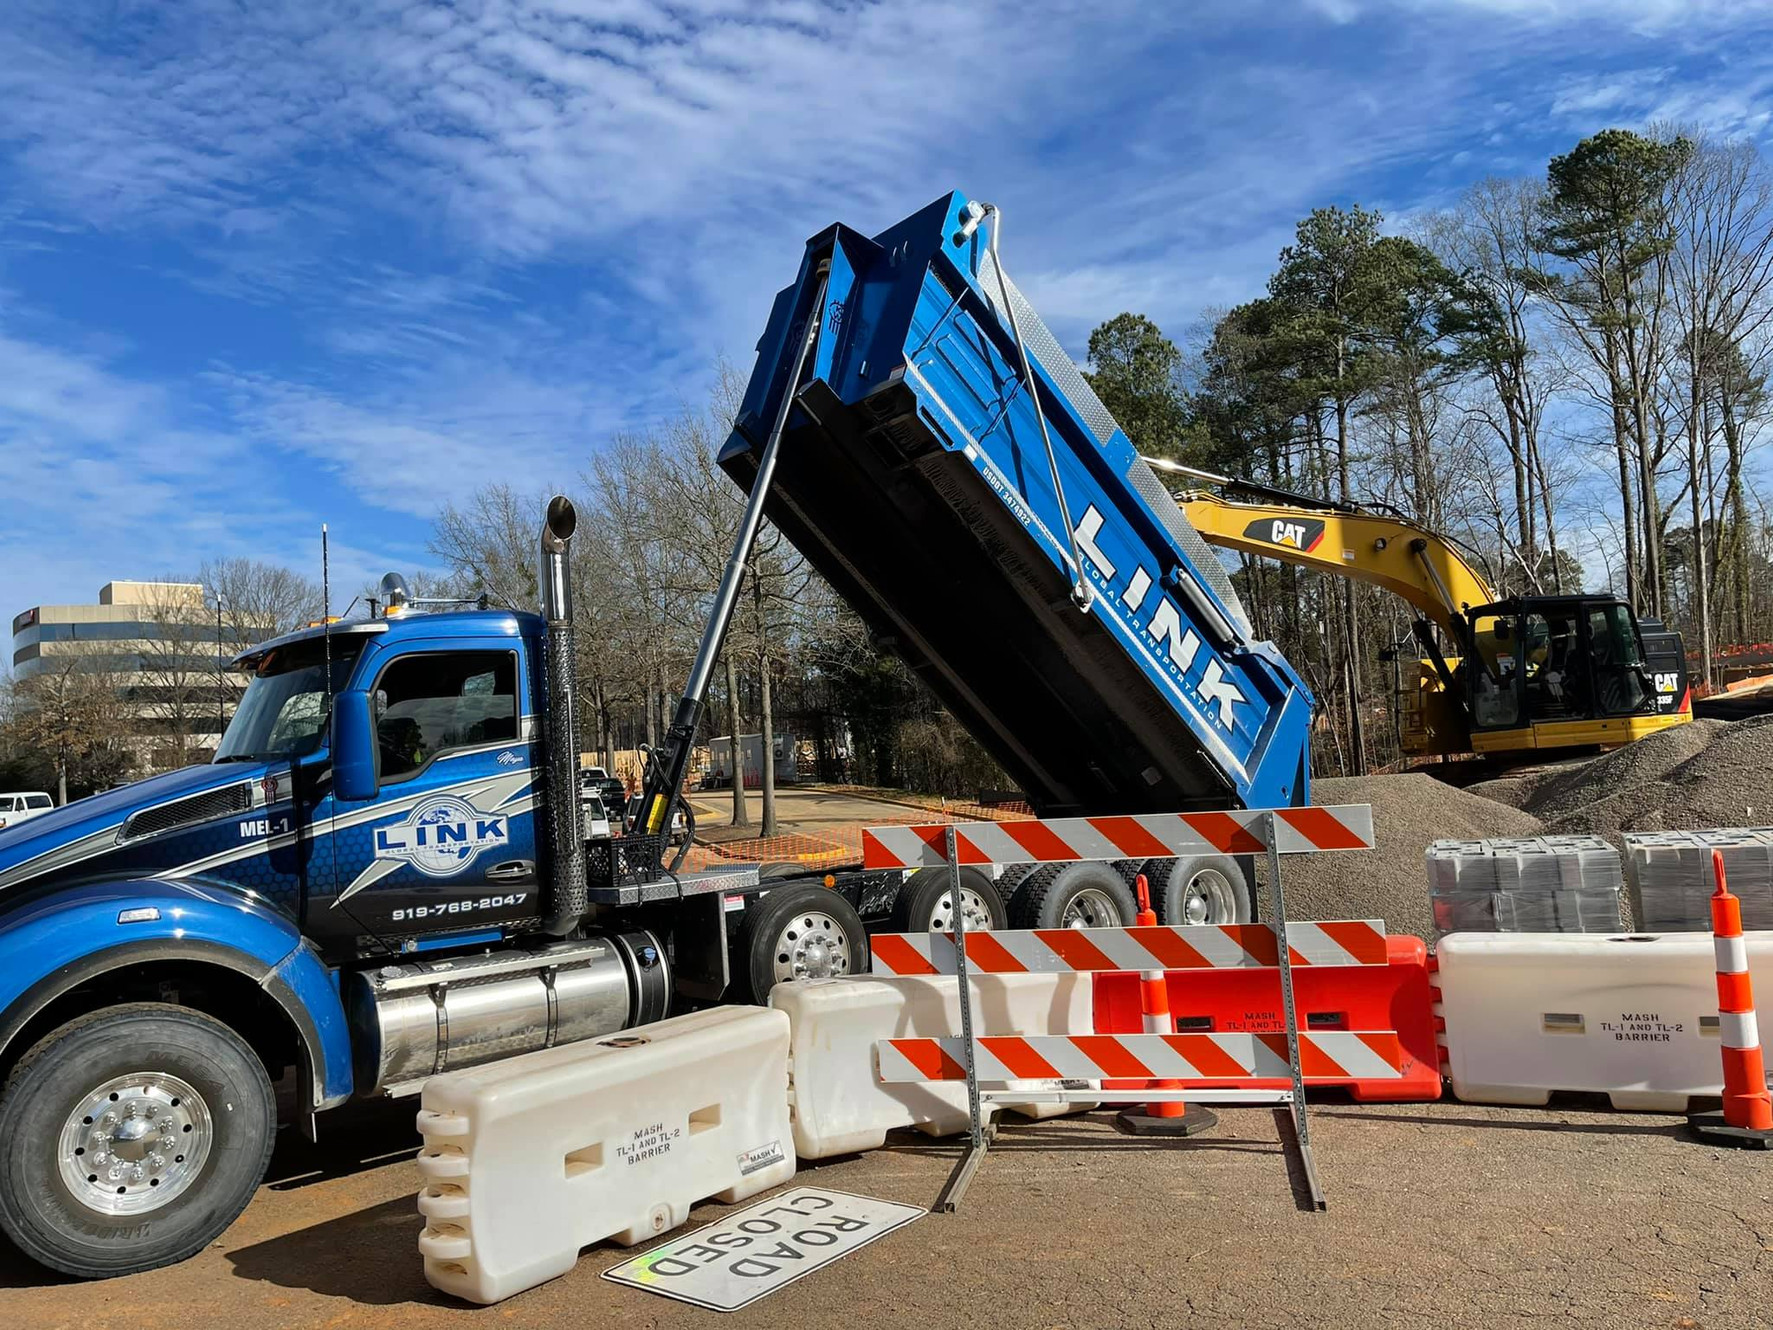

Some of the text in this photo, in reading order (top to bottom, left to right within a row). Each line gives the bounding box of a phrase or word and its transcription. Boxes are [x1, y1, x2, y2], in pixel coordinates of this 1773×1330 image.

[983, 467, 1004, 492] USDOT
[1272, 520, 1306, 549] CAT
[1075, 503, 1249, 734] LINK
[1126, 610, 1221, 729] TRANSPORTATION
[1655, 673, 1678, 692] CAT
[240, 818, 288, 837] MEL-1
[377, 819, 505, 850] LINK
[424, 838, 500, 850] TRANSPORTATION
[392, 893, 527, 920] 919-768-2047
[1244, 1012, 1275, 1020] MASH
[1600, 1023, 1624, 1031] TL-1
[1656, 1024, 1684, 1032] TL-2
[1621, 1013, 1659, 1021] MASH
[1615, 1033, 1670, 1041] BARRIER
[634, 1122, 663, 1140] MASH
[616, 1128, 680, 1158] TL-1 AND TL-2
[628, 1143, 671, 1166] BARRIER
[750, 1151, 770, 1163] MASH
[648, 1196, 834, 1277] CLOSED
[728, 1215, 870, 1278] ROAD
